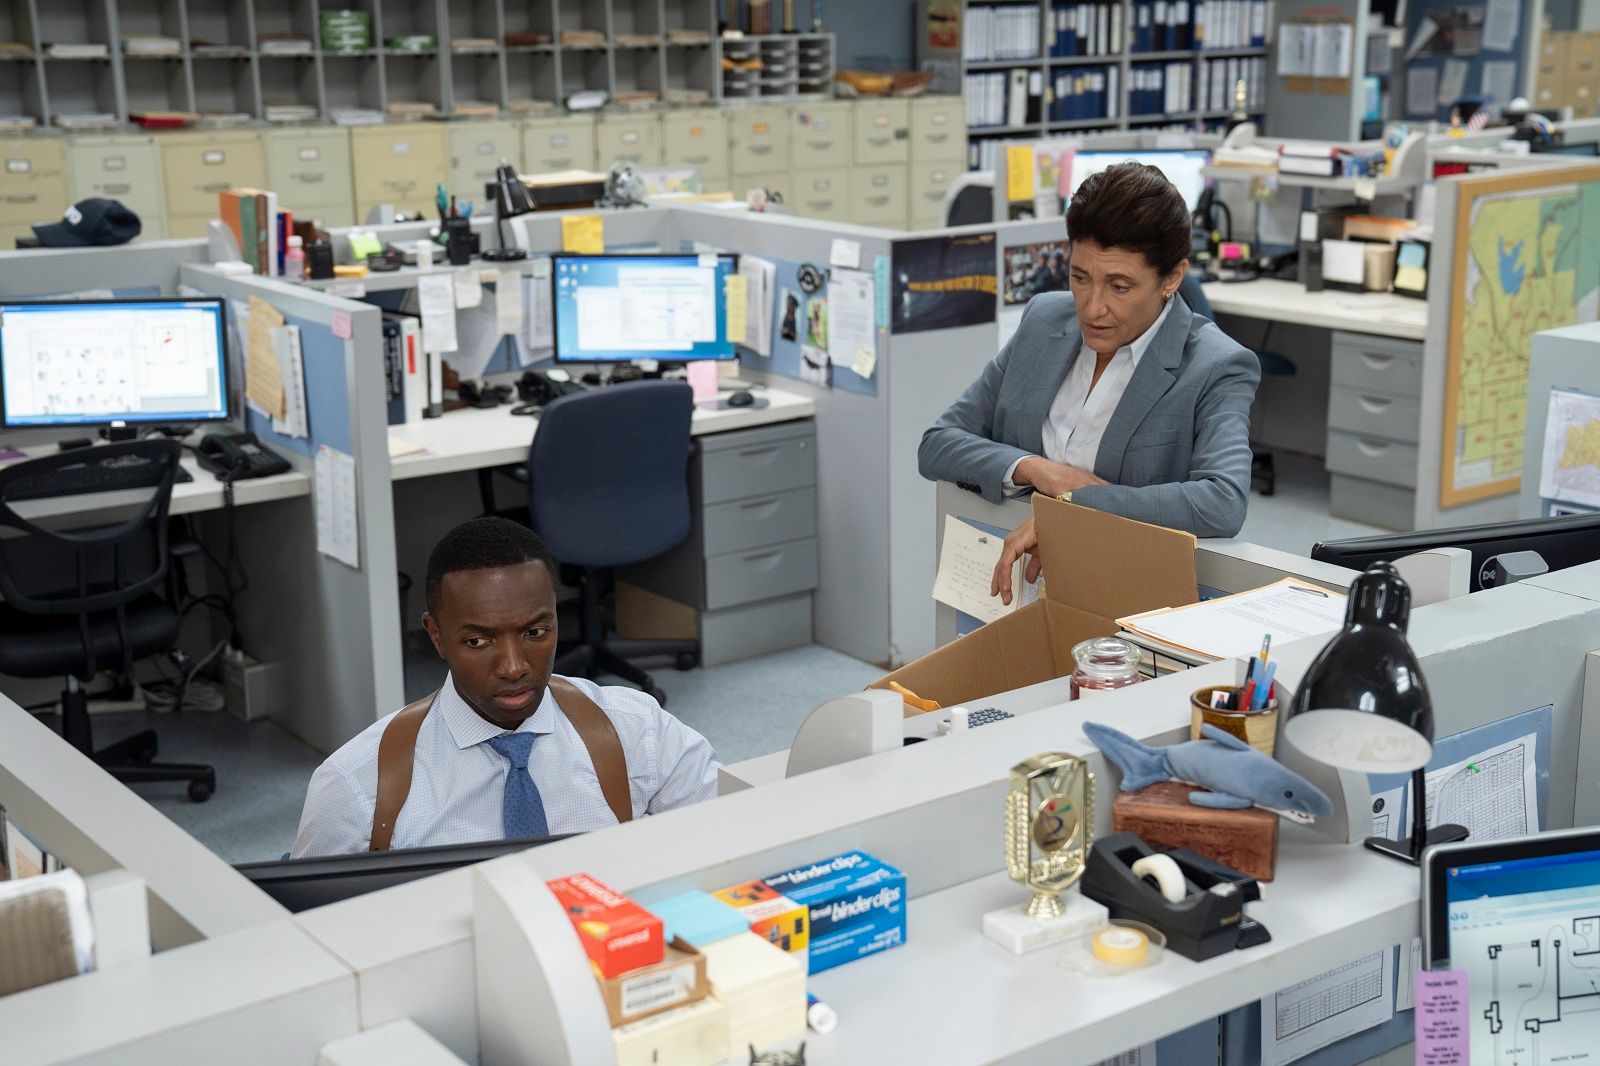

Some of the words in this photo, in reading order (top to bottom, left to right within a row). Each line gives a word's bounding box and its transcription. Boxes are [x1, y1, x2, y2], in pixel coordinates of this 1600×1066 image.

[788, 862, 832, 884] binder
[831, 853, 863, 871] clips
[810, 905, 832, 921] Small
[831, 895, 873, 922] binder
[872, 886, 901, 909] clips
